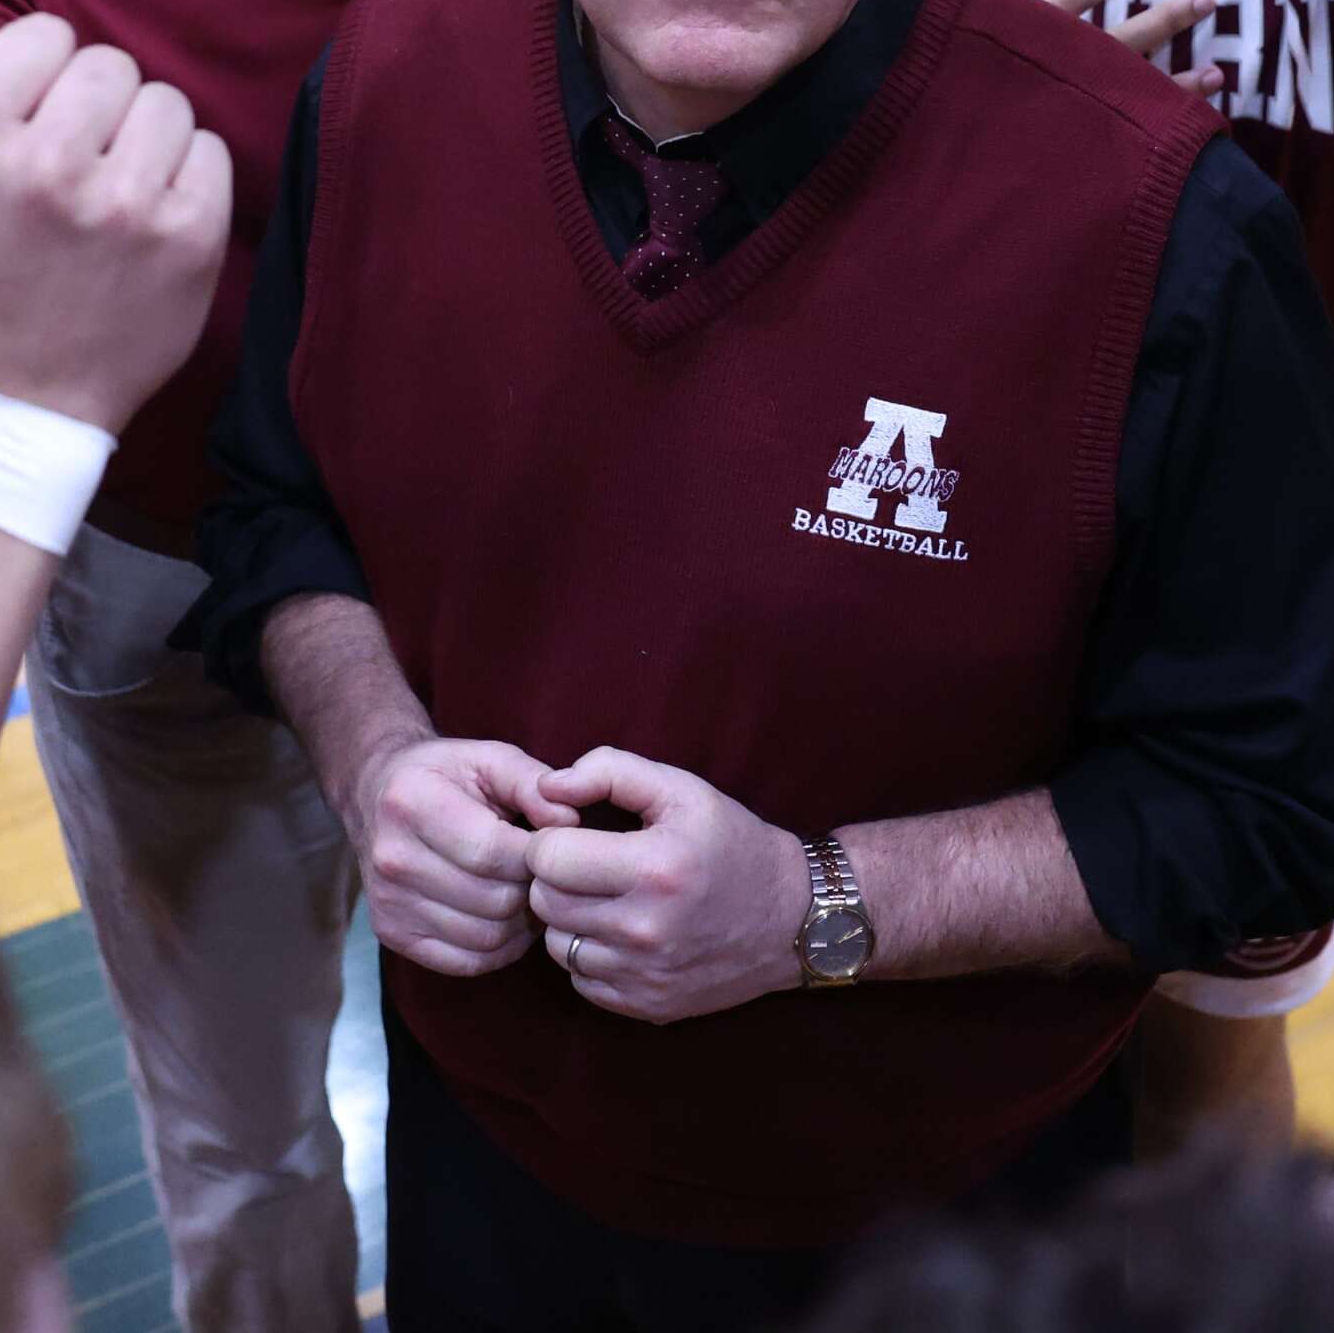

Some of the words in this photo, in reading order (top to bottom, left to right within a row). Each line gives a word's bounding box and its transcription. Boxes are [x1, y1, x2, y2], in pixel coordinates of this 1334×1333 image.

[826, 396, 948, 533] A
[828, 447, 959, 502] MAROONS
[792, 508, 969, 560] BASKETBALL
